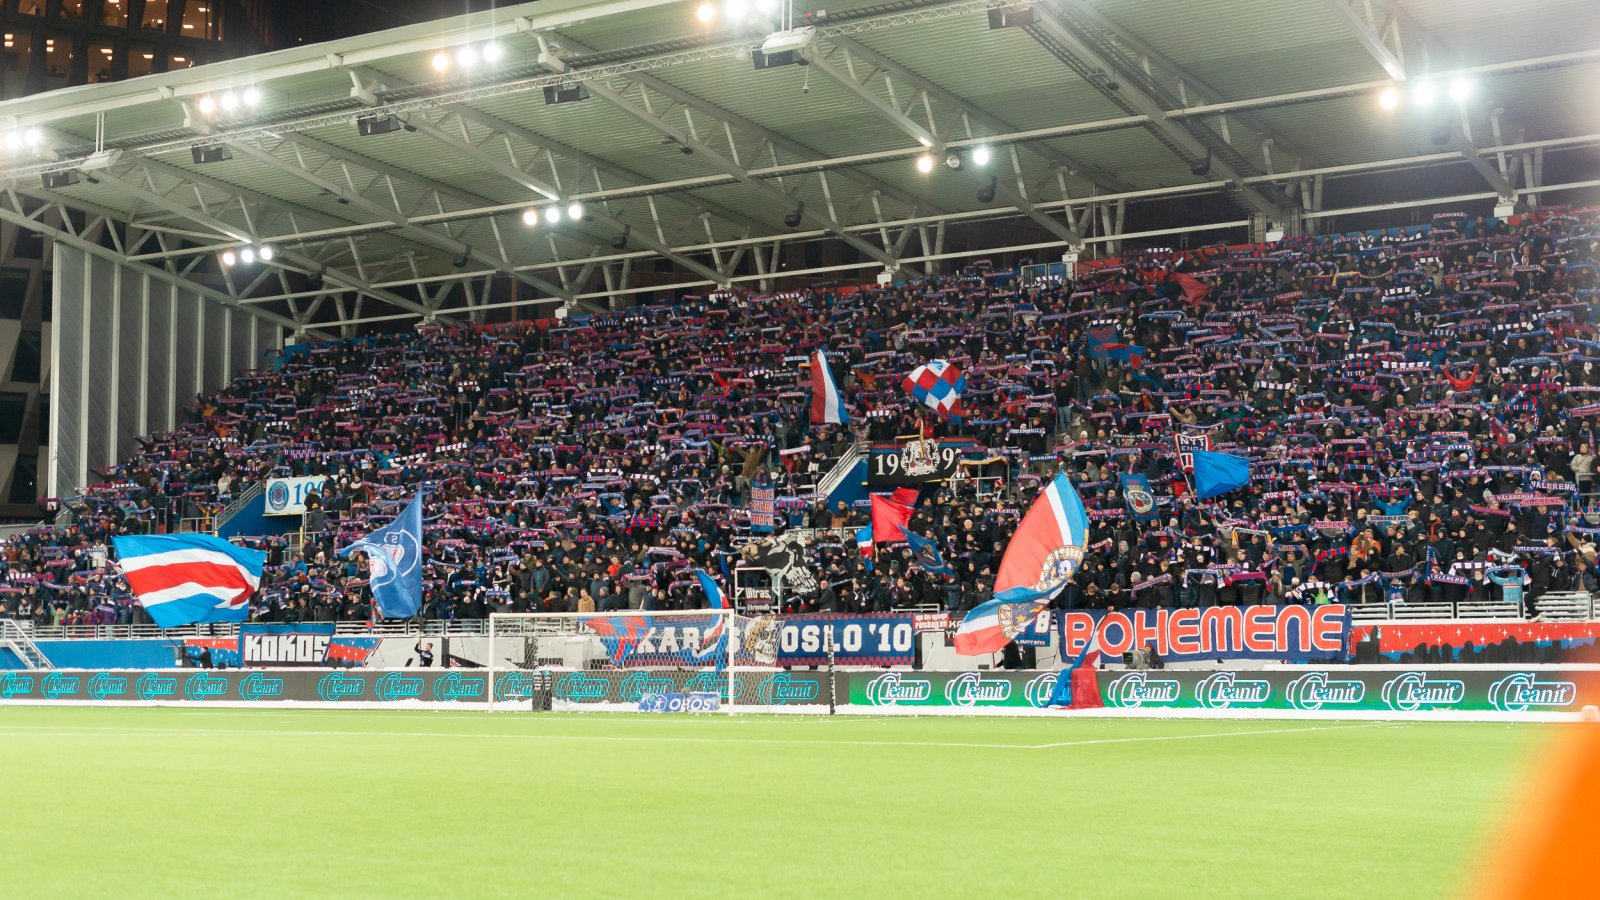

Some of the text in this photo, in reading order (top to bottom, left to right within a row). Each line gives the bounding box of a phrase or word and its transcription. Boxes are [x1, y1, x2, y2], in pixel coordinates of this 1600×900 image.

[1180, 437, 1204, 446] NYT
[875, 454, 898, 475] 19
[781, 624, 861, 652] OSLO
[1065, 604, 1345, 657] BOHEMENE
[244, 635, 331, 663] KOKOS
[869, 673, 928, 708] Cleanit
[948, 673, 1007, 708] Cleanit
[1111, 673, 1176, 708] Cleanit
[1198, 673, 1265, 709] Cleanit
[1288, 673, 1361, 709] Cleanit
[1386, 673, 1461, 710] Cleanit
[1492, 673, 1572, 711] Cleanit
